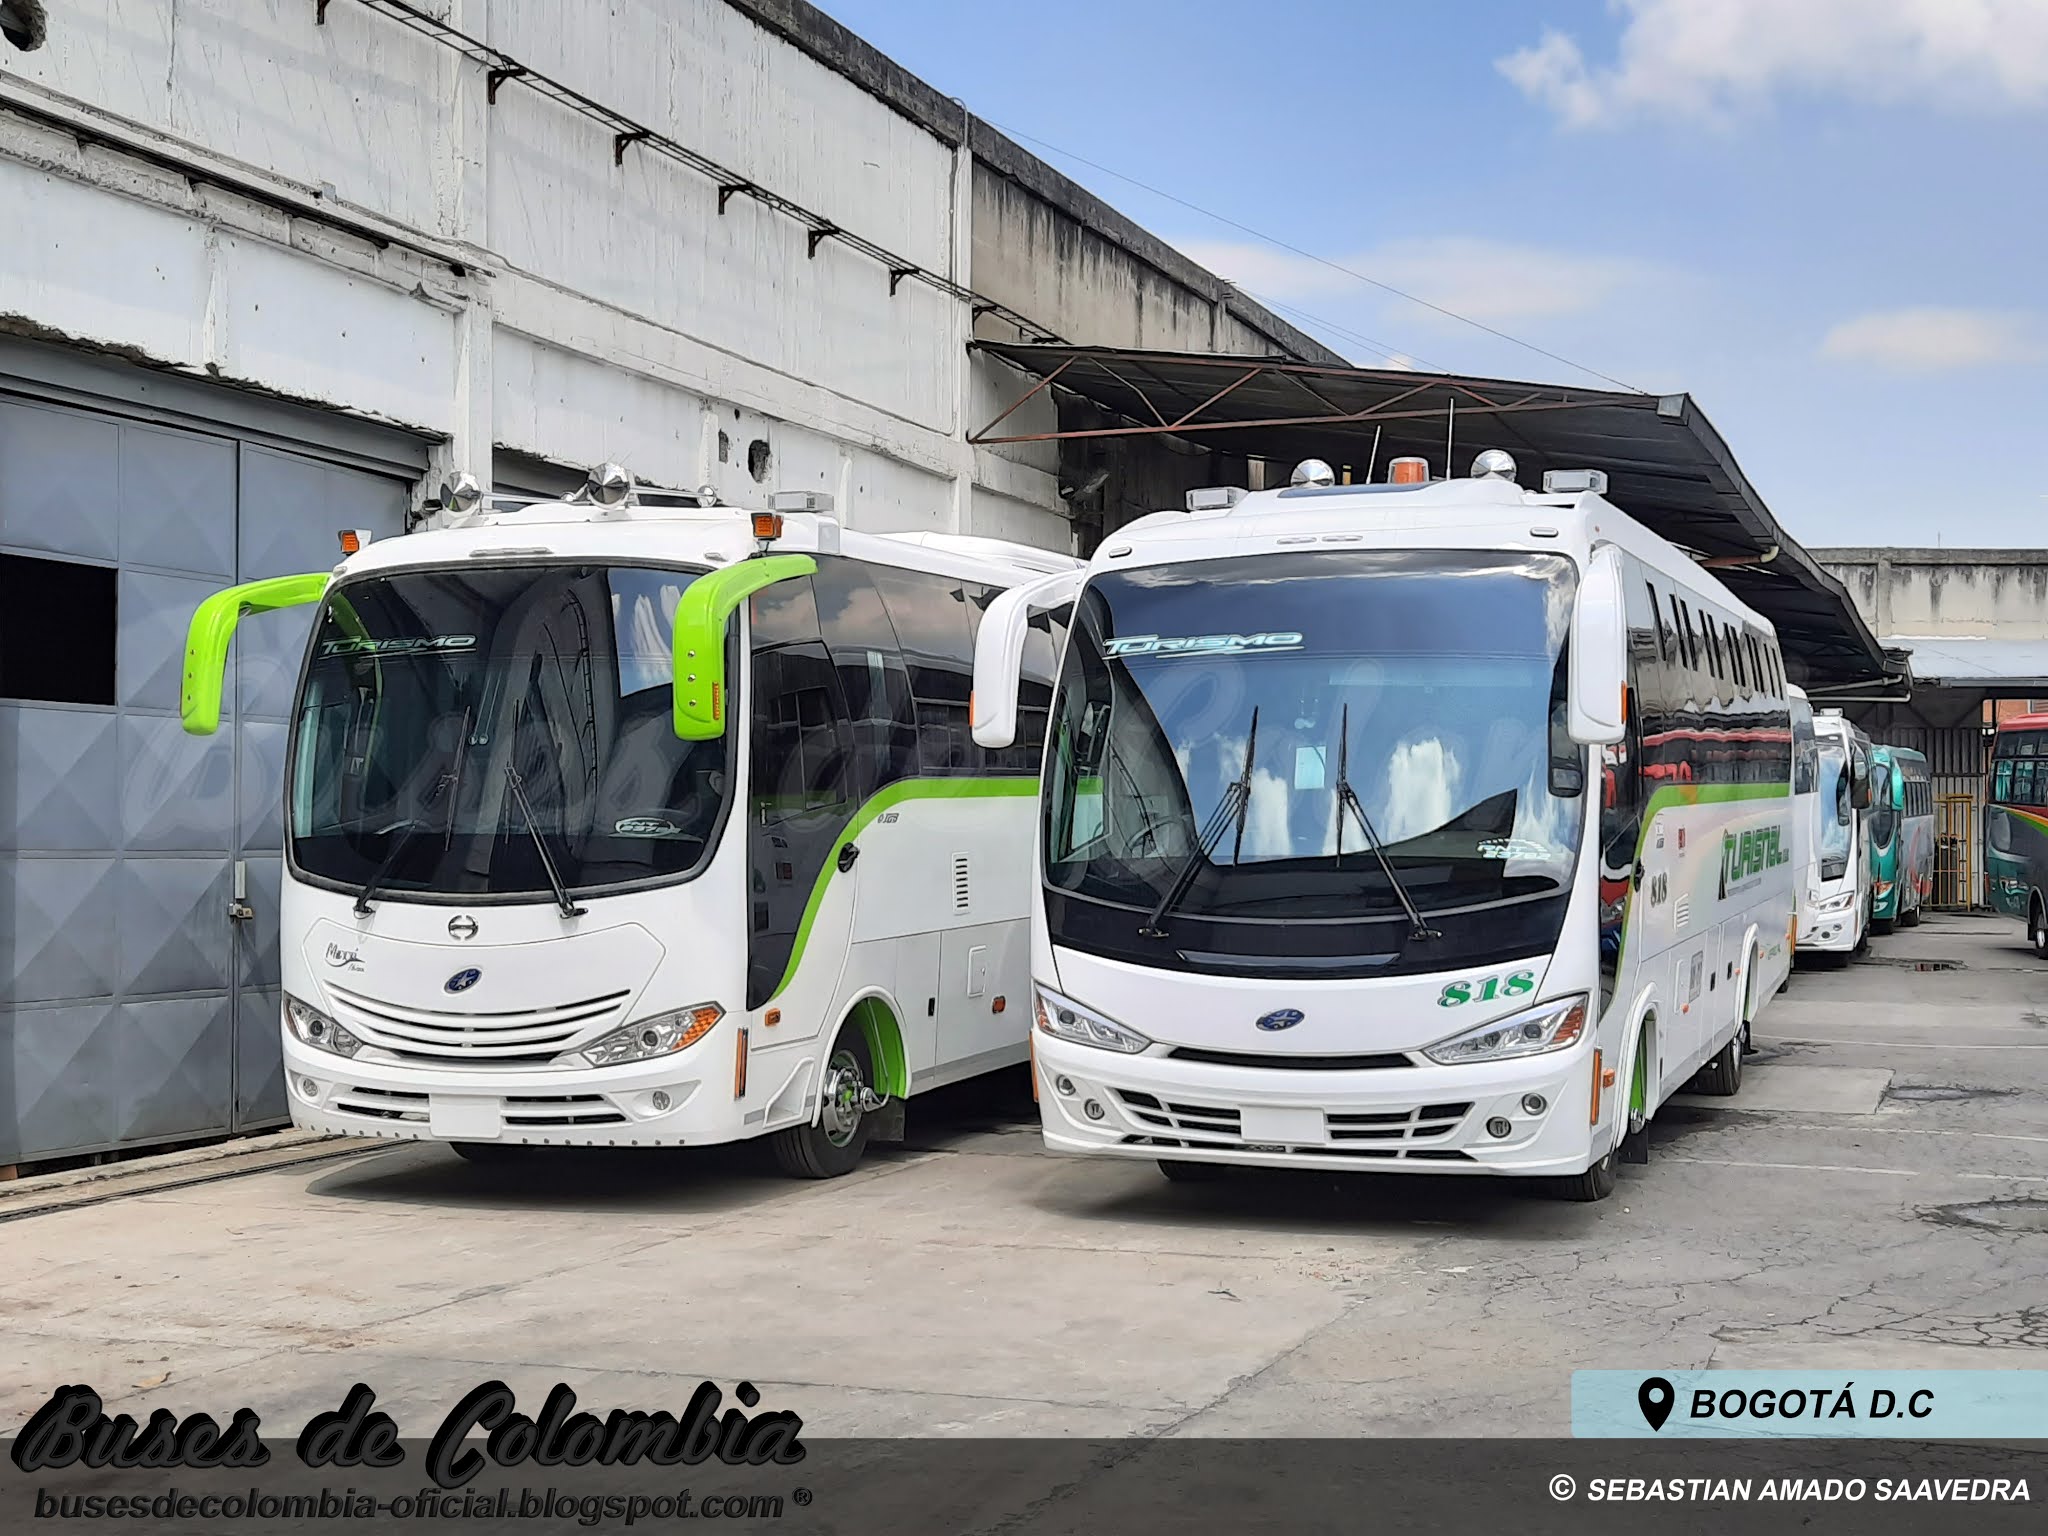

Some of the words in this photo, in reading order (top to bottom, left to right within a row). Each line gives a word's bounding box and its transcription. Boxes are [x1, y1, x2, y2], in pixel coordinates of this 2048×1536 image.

[1103, 632, 1302, 655] TURISMO
[1651, 871, 1667, 908] 818
[1437, 969, 1534, 1008] 818
